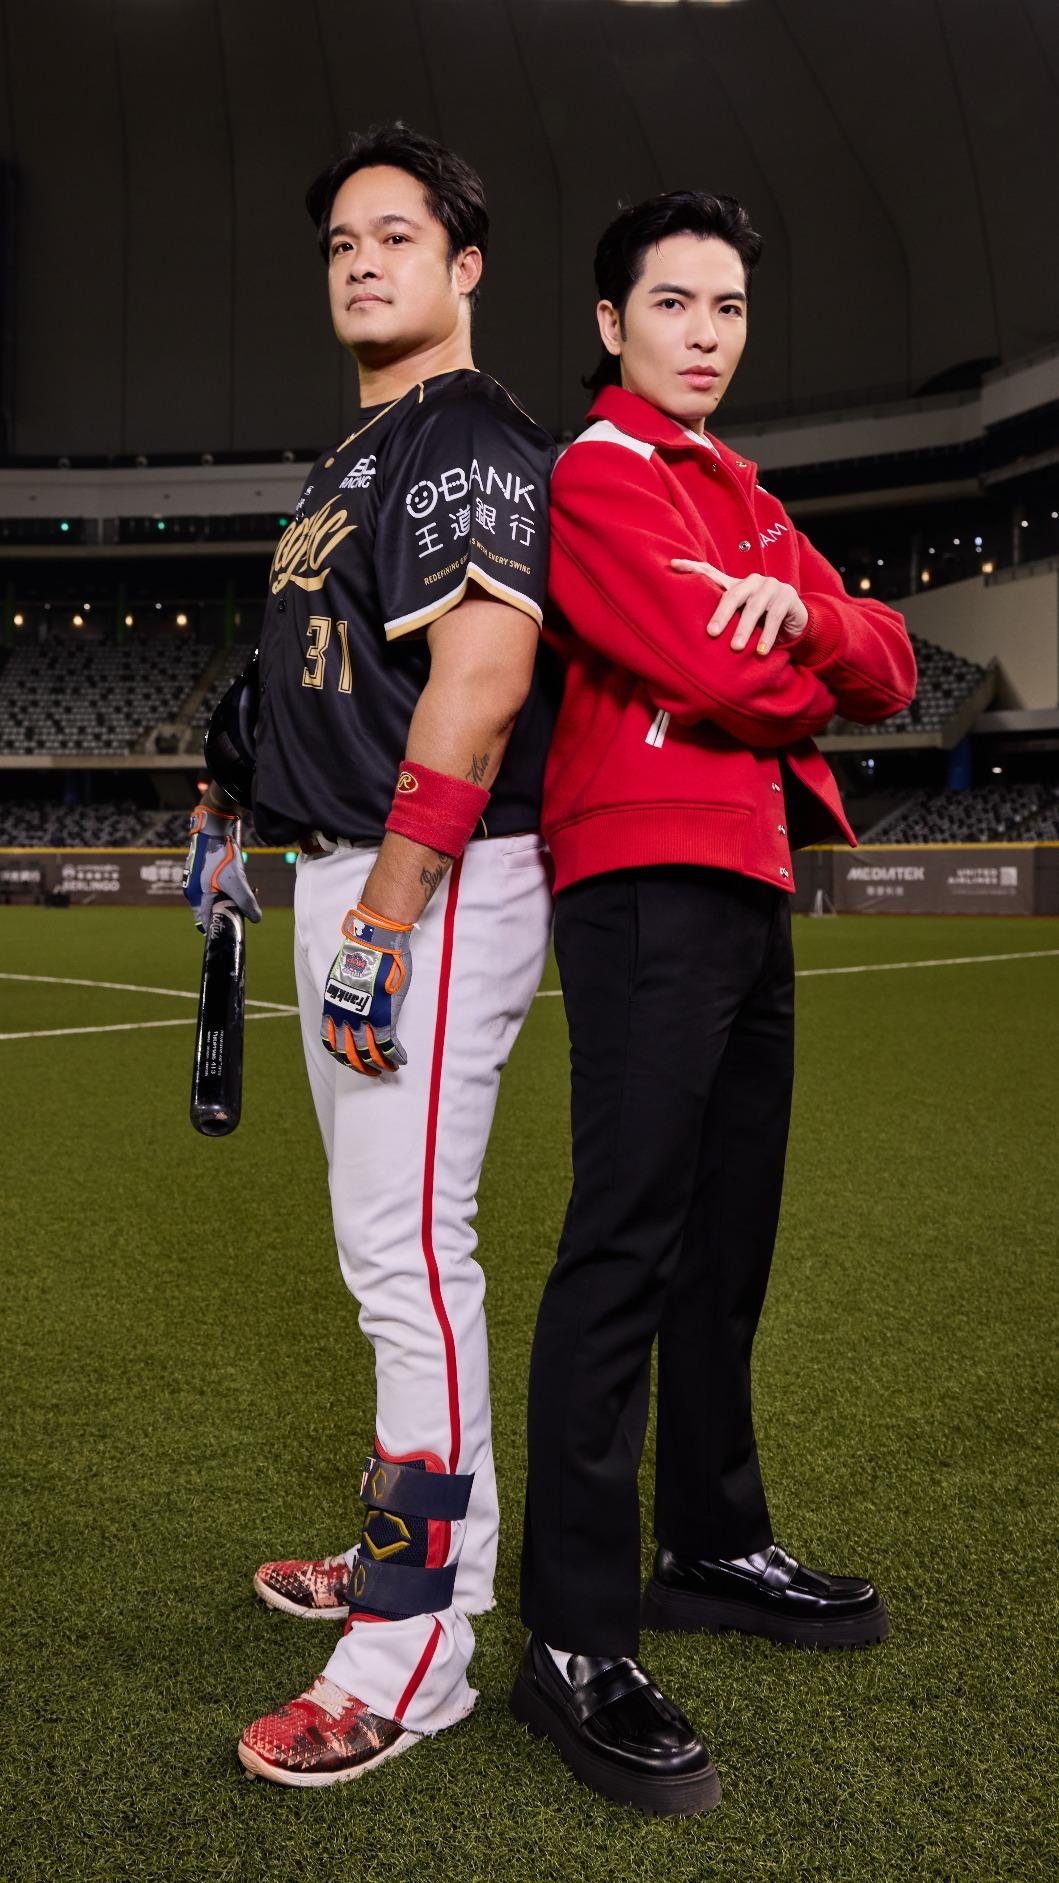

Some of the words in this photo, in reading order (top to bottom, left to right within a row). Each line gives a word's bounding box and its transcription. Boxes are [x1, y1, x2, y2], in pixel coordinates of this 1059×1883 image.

[414, 497, 536, 558] 王道銀行
[423, 559, 460, 587] REDEFINING
[488, 551, 509, 566] EVERY
[509, 560, 532, 575] SWING
[301, 615, 354, 695] 31
